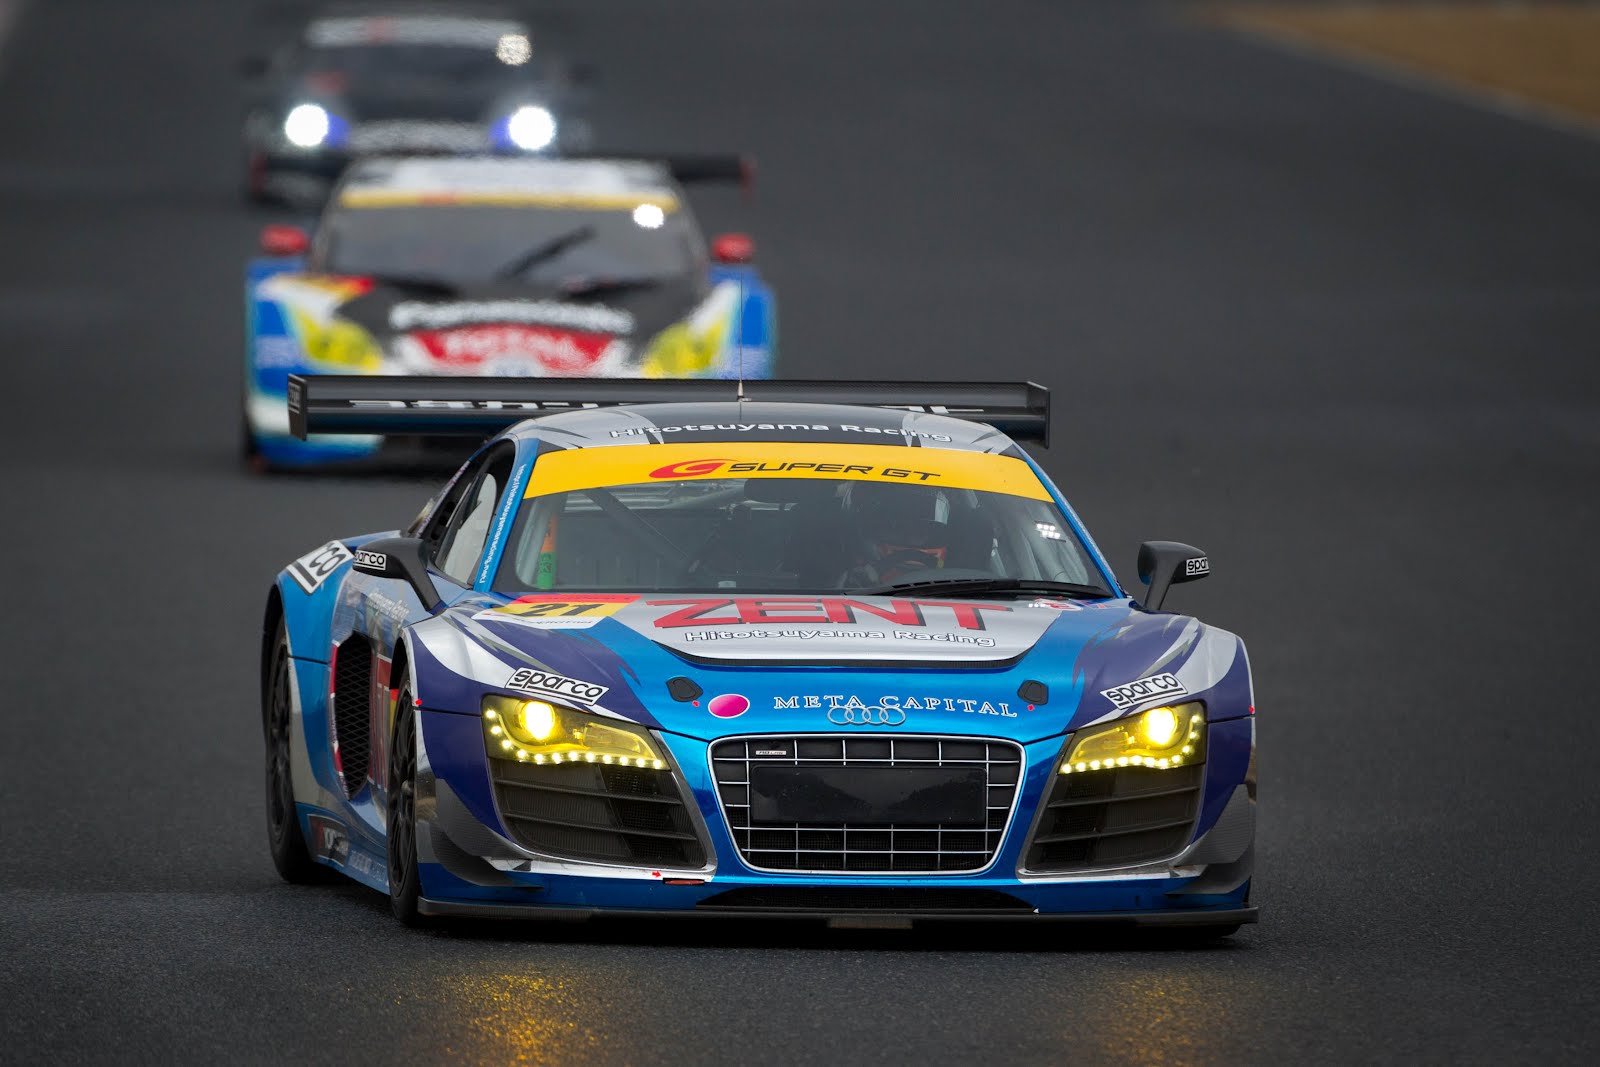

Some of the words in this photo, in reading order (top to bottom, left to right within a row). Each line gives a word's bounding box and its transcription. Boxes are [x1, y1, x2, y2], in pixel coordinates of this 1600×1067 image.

[609, 422, 829, 438] Hitotsuyama
[840, 423, 953, 443] Racing
[727, 462, 867, 475] SUPER
[881, 467, 941, 481] GT
[509, 603, 606, 618] 21
[644, 596, 1014, 632] ZENT
[684, 628, 886, 642] Hitotsuyama
[892, 629, 997, 648] Racing
[513, 669, 604, 699] sparco
[1106, 674, 1179, 704] sparco
[773, 695, 866, 710] META
[879, 695, 1019, 718] CAPITAL
